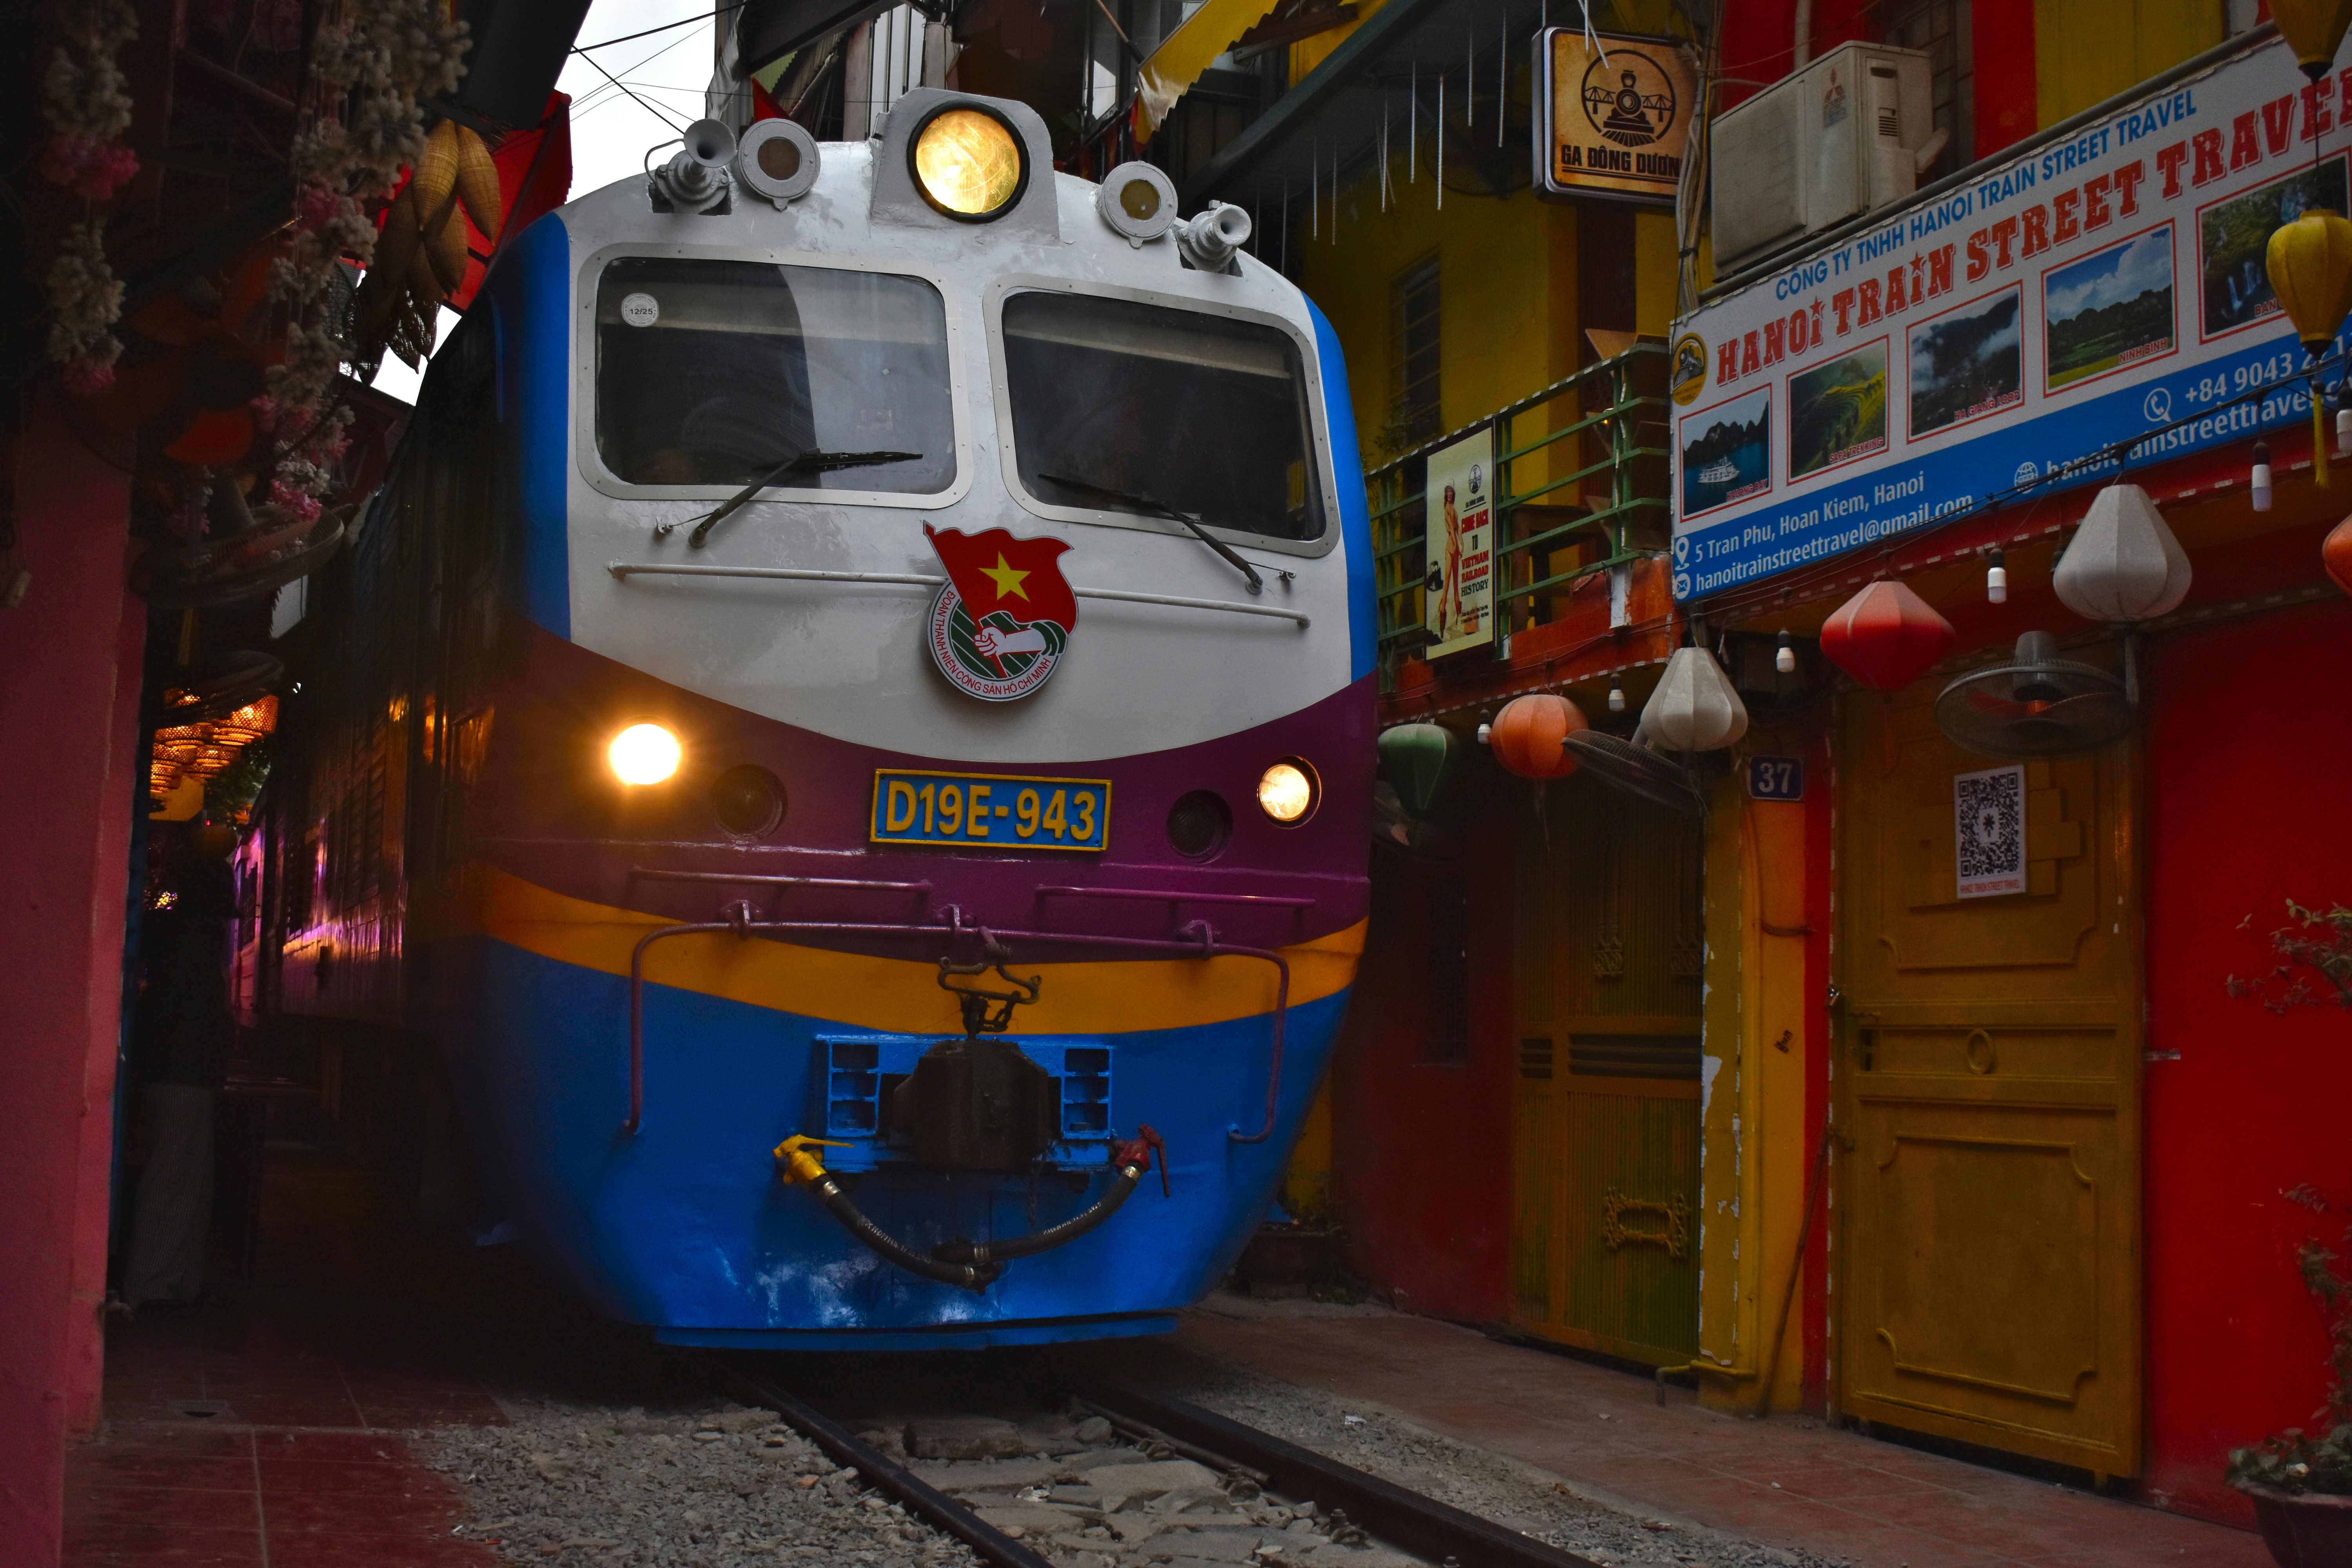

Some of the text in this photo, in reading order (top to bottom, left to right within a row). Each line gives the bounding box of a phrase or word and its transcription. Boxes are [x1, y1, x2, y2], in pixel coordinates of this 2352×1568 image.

[1561, 144, 1683, 177] GA ĐÔNG DƯƠN
[1776, 90, 2196, 300] CÔNG TY TNHH HANOI TRAIN STREET TRAVEL
[1967, 159, 2145, 283] STREET
[2254, 298, 2277, 317] BAN
[2119, 336, 2168, 365] NINH BINH
[2185, 373, 2228, 403] +84
[2234, 353, 2293, 392] 9043
[1967, 399, 1996, 417] GIANG
[1996, 390, 2020, 406] LOOP
[1829, 436, 1884, 463] SAPA TREKKING
[1461, 508, 1488, 534] COME BACK
[1695, 470, 1925, 563] 5 Tran Phu, Hoan Kiem, Hanoi
[1472, 534, 1478, 550] TO
[1462, 550, 1489, 570] VIETNAM
[1462, 564, 1488, 583] RAILROAD
[1461, 579, 1489, 597] HISTORY
[935, 590, 1051, 695] ĐOÀN THANH NIÊN CỘNG SẢN HỒ CHÍ MINH
[1759, 763, 1793, 793] 37
[886, 780, 1096, 841] D19E-943
